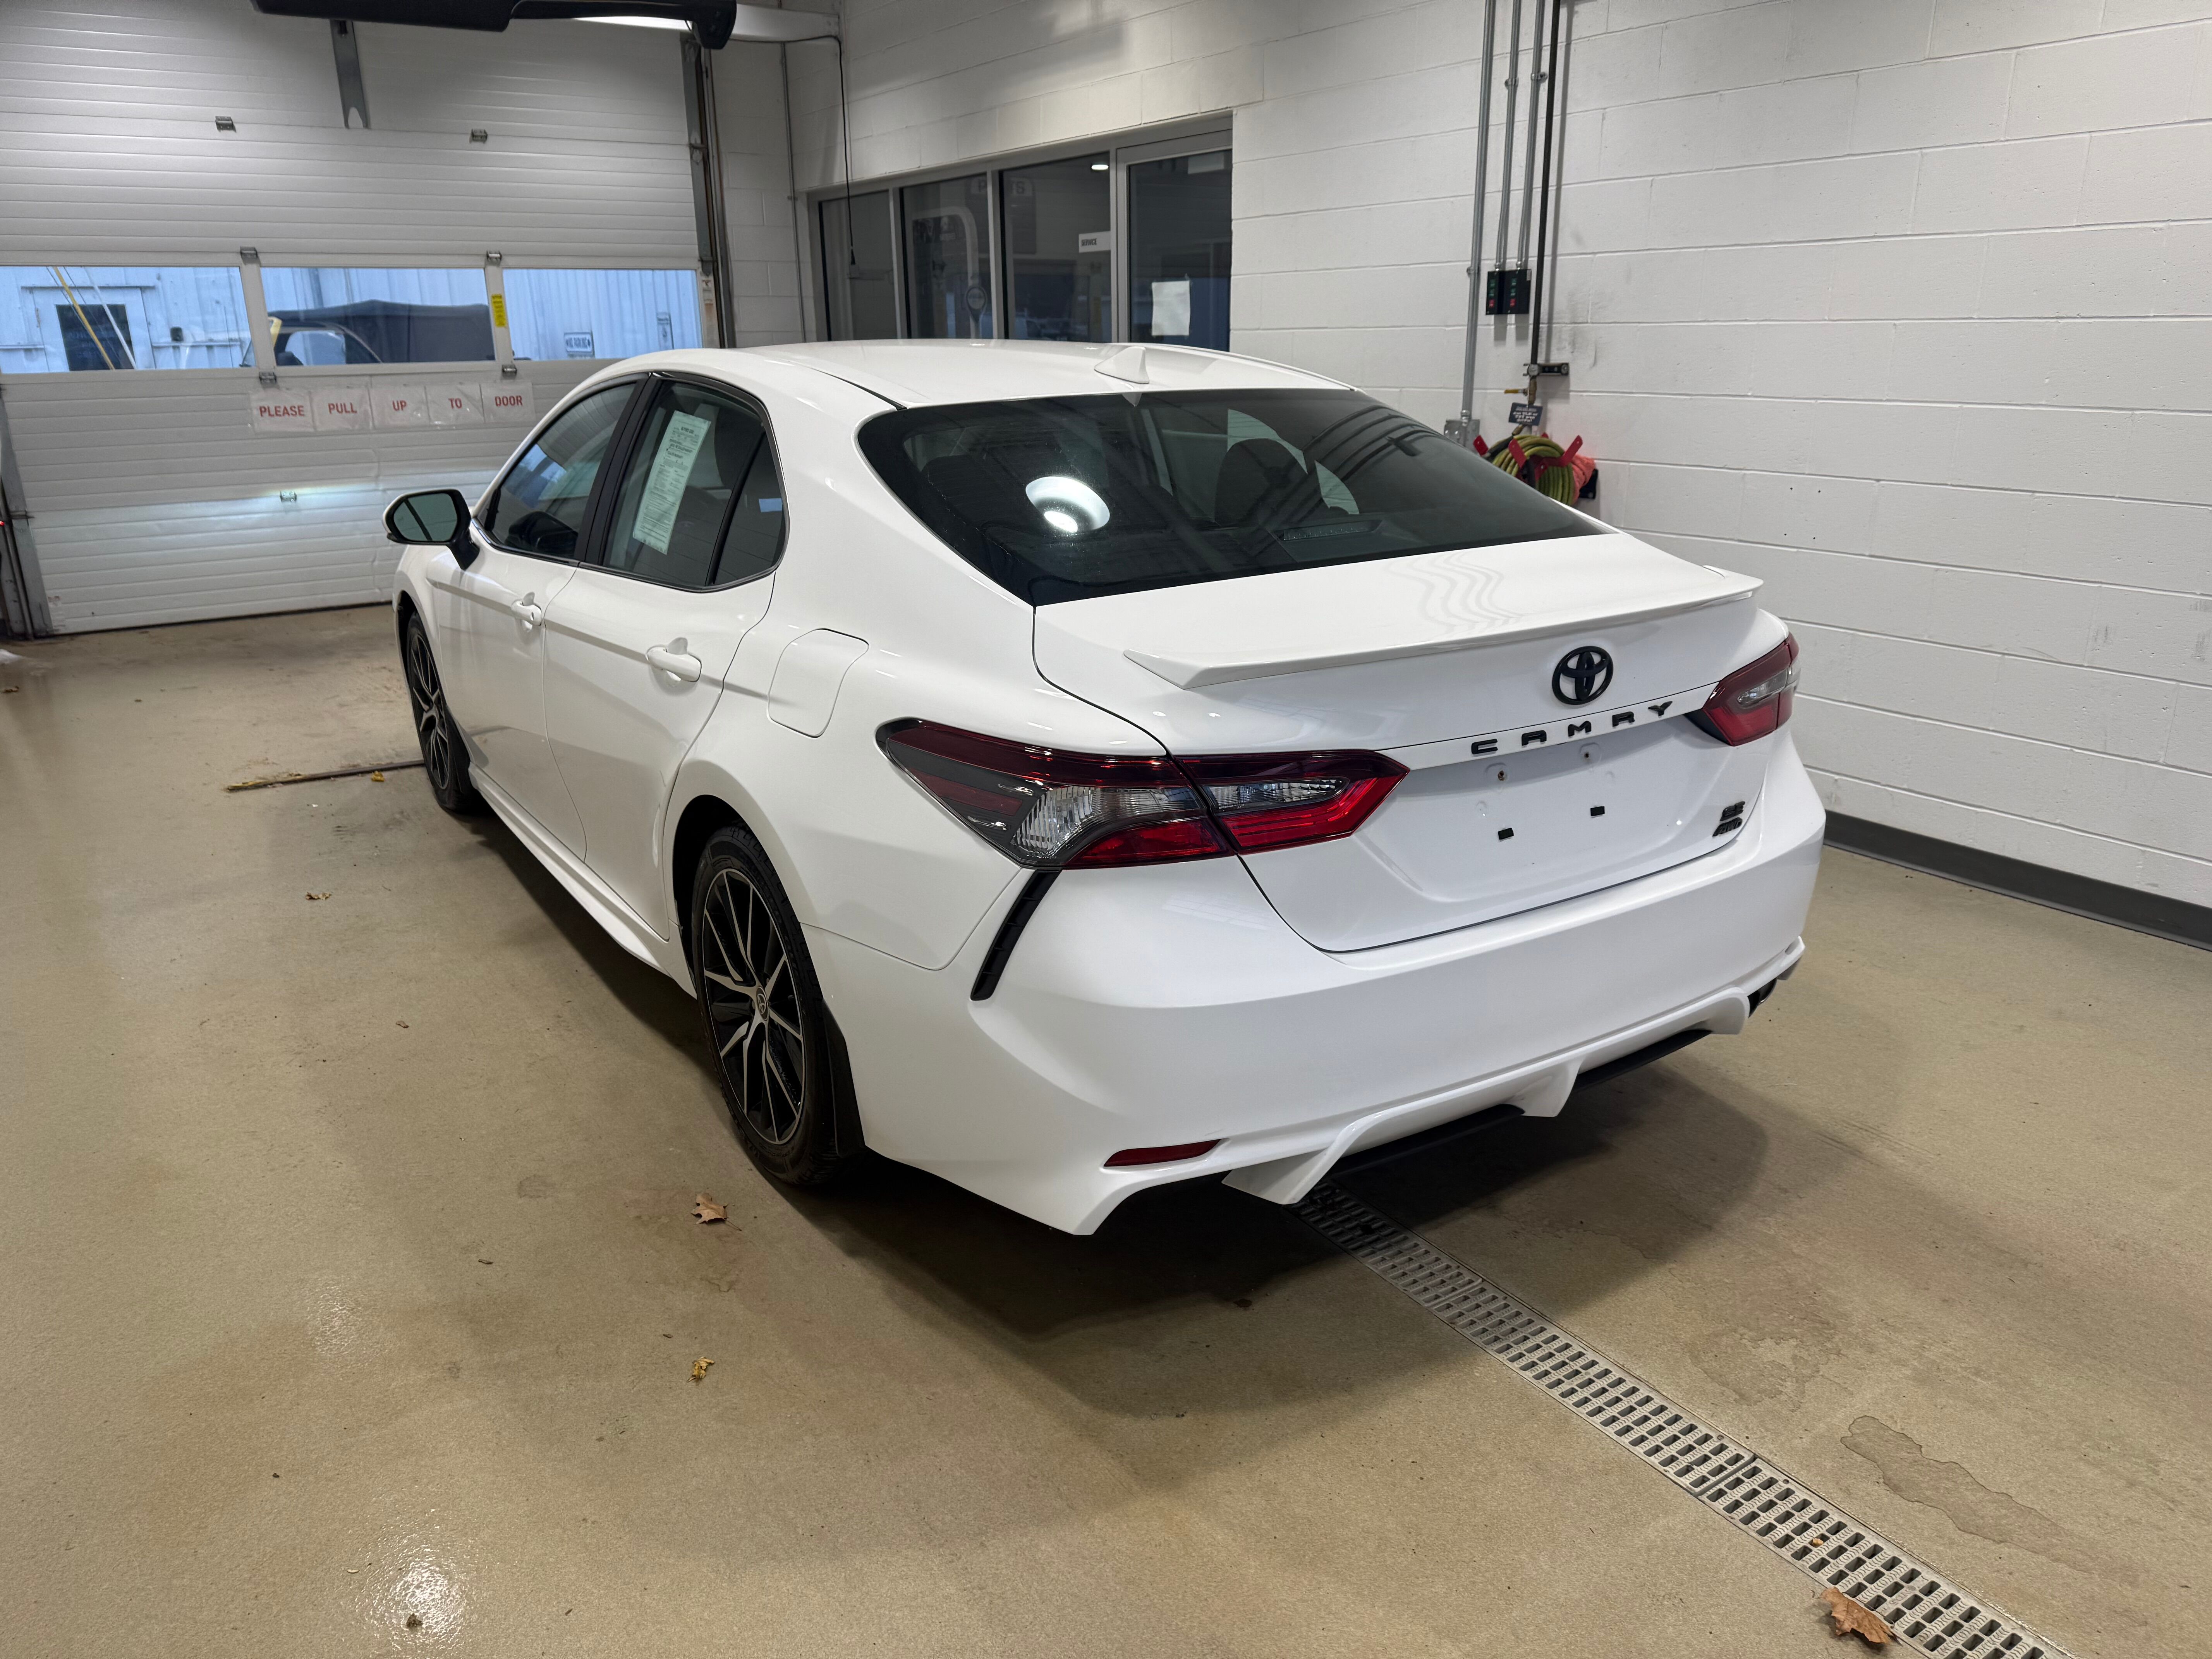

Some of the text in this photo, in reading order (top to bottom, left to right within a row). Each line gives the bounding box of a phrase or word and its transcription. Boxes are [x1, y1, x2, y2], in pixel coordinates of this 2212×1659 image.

[259, 395, 522, 417] PLEASE PULL UP TO DOOR
[1471, 701, 1673, 755] CAMRY
[1720, 801, 1745, 821] SE
[1712, 817, 1743, 837] AWD
